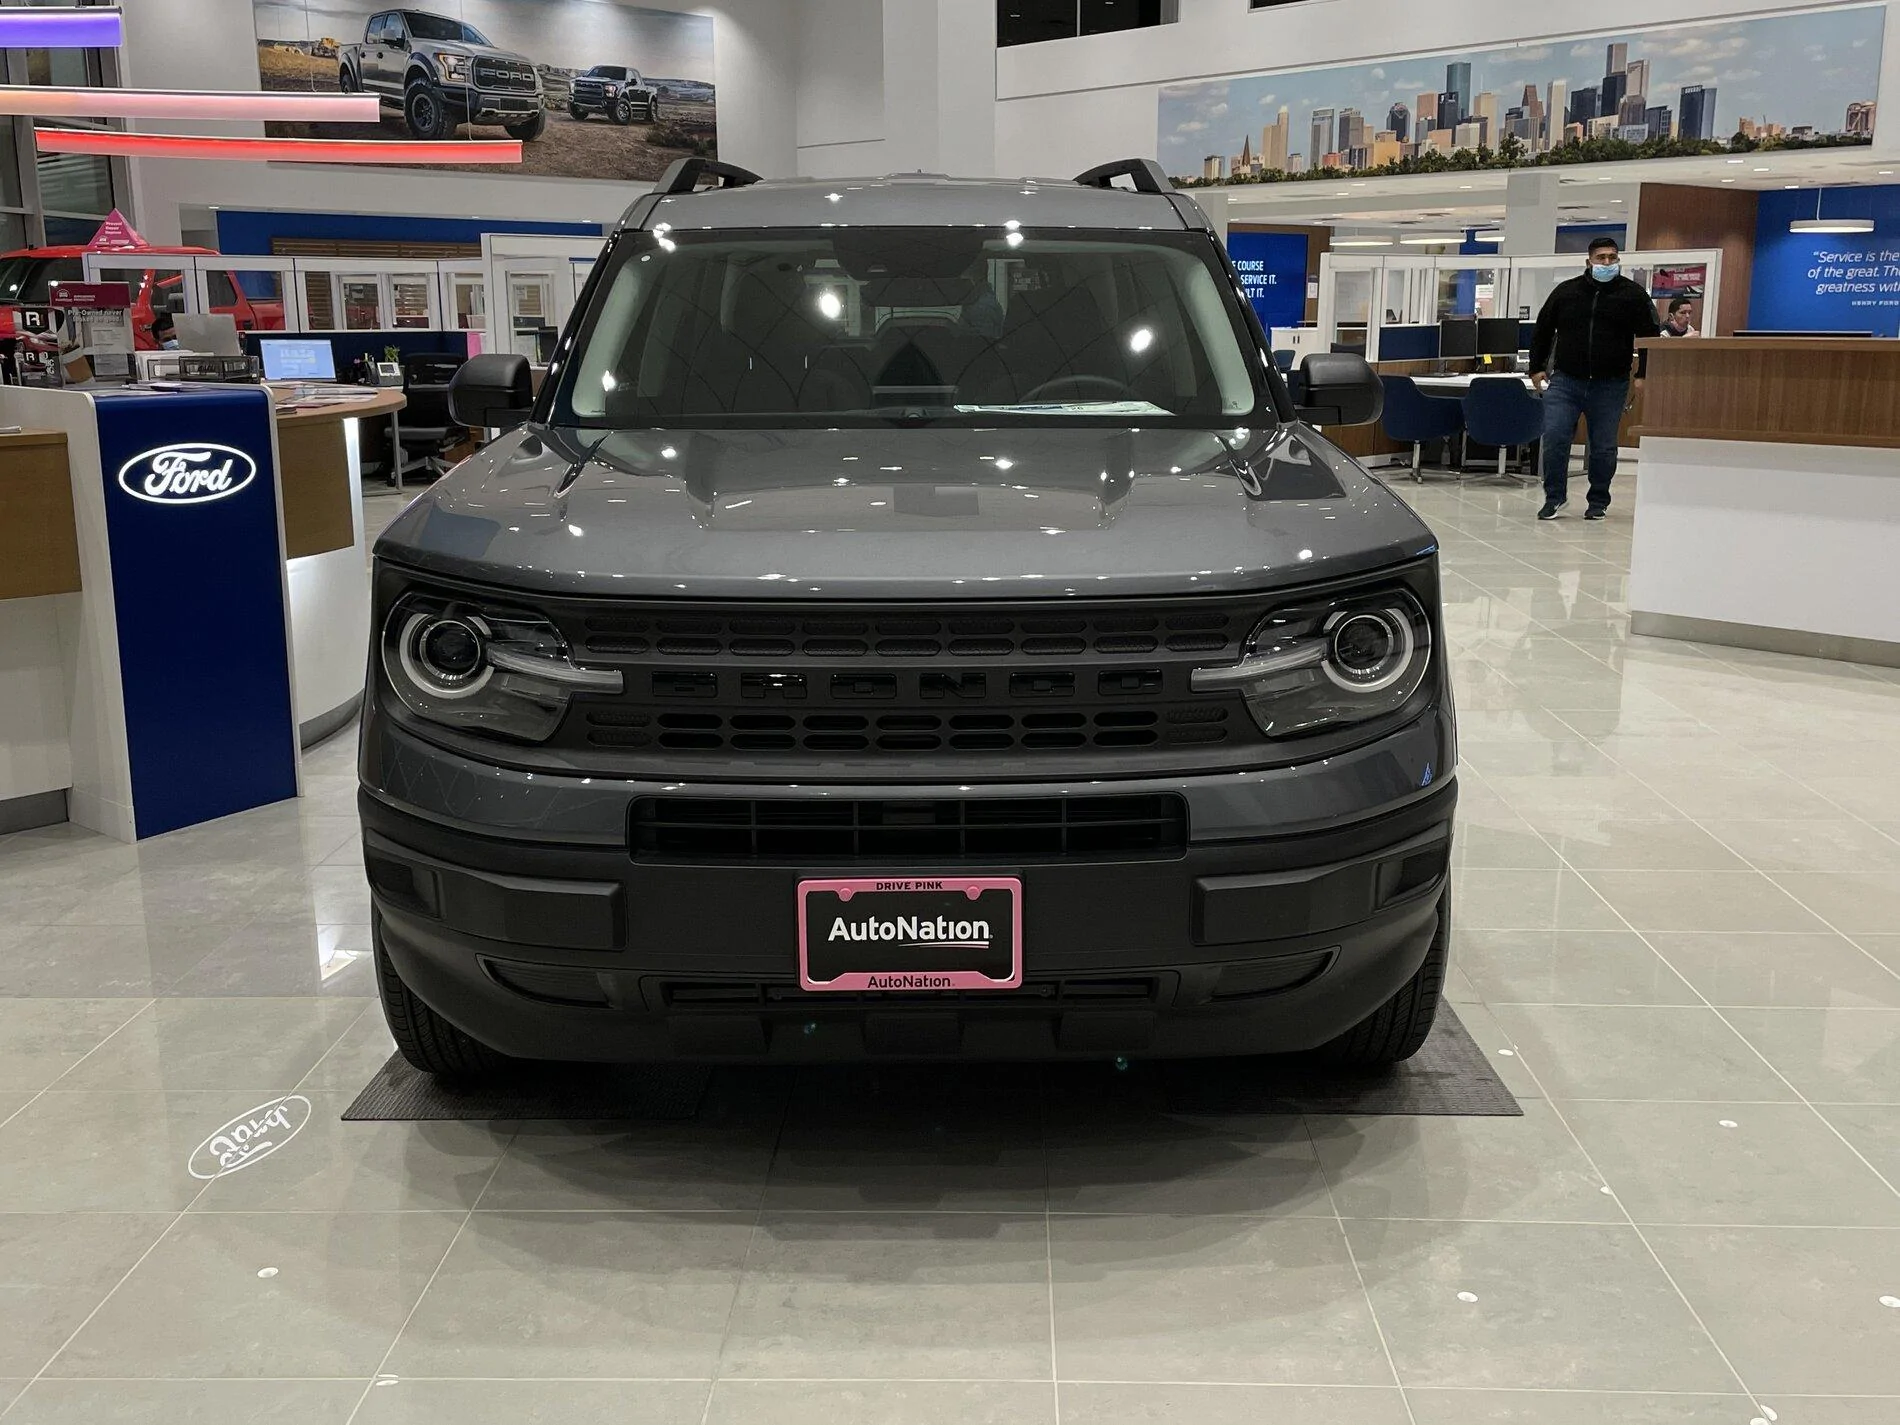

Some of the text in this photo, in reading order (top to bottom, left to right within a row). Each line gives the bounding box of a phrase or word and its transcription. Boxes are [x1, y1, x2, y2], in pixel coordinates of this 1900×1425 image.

[480, 67, 535, 82] FORD
[1865, 250, 1876, 262] is
[1879, 249, 1899, 262] the
[1237, 260, 1264, 271] COURSE
[1807, 266, 1822, 280] of
[1824, 265, 1844, 278] the
[1845, 266, 1880, 280] great.
[1240, 274, 1277, 285] SERVICE IT.
[1256, 287, 1265, 298] IT.
[1816, 281, 1876, 295] greatness
[144, 451, 234, 496] Ford
[652, 669, 1163, 699] BRONCO
[876, 881, 943, 891] DRIVE PINK
[827, 915, 990, 941] AutoNation
[867, 974, 951, 988] AutoNation
